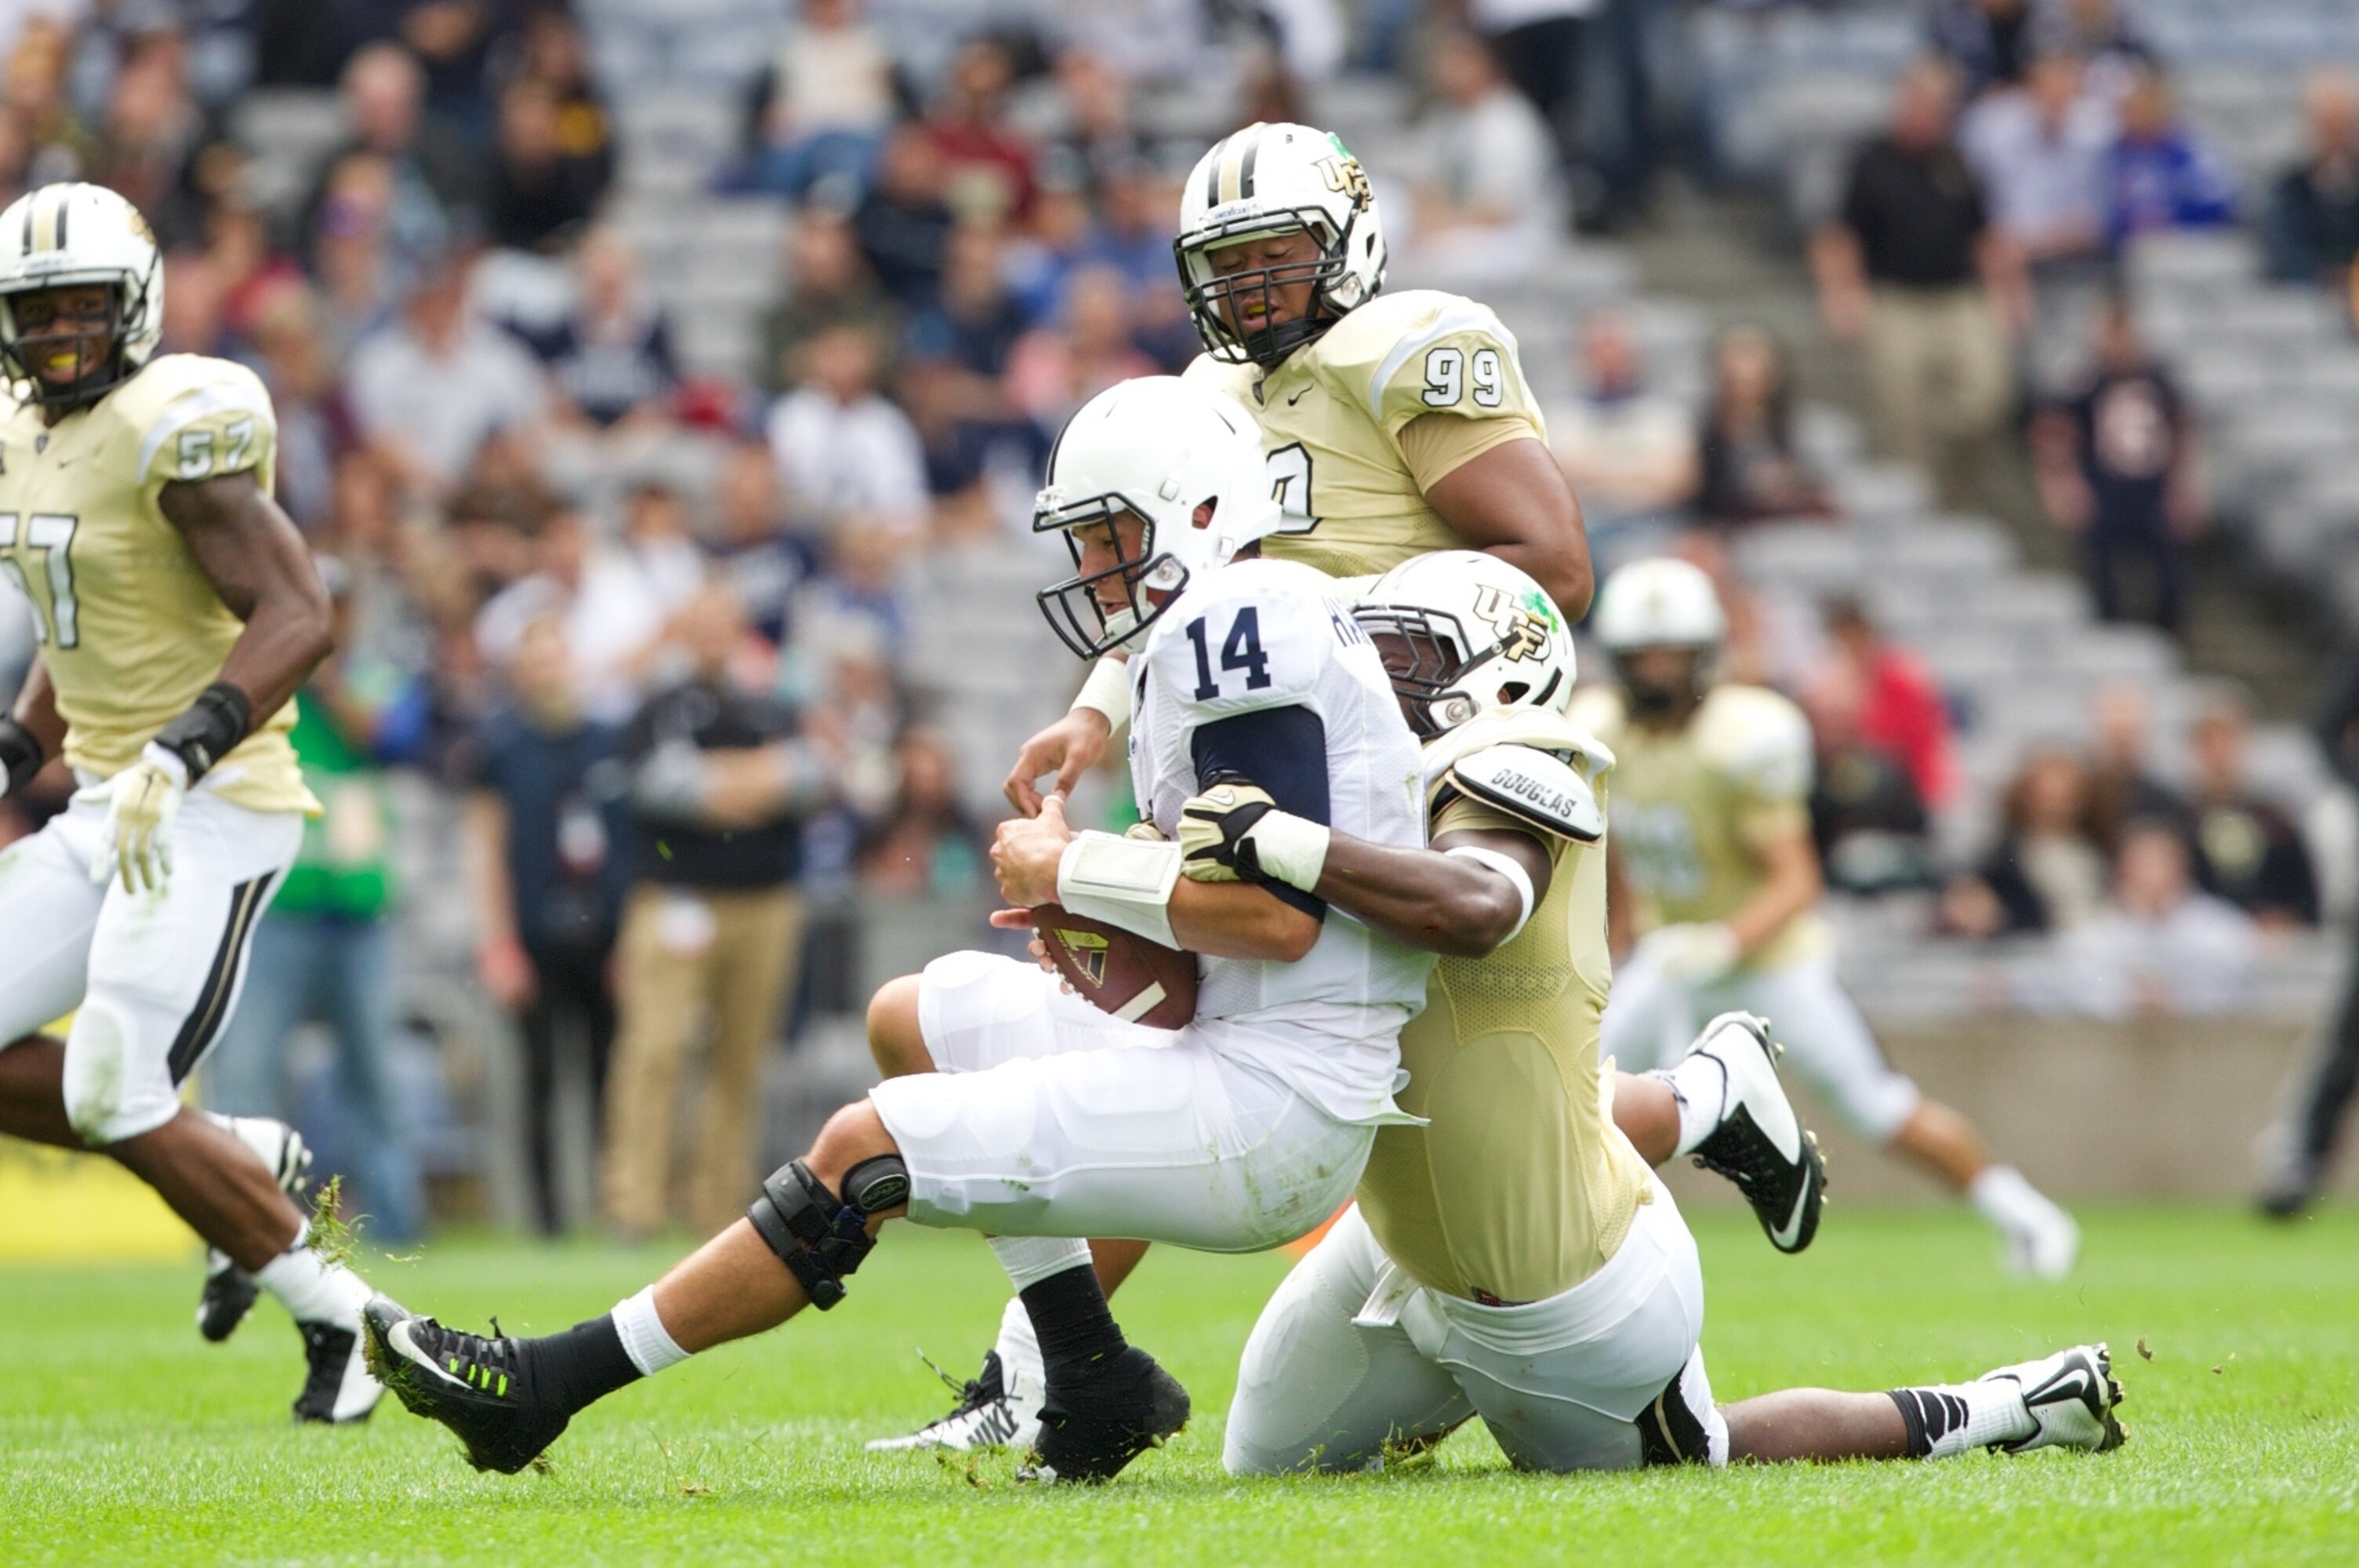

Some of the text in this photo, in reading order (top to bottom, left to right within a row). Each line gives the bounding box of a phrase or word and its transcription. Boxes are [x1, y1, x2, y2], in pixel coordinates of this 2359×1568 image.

[1422, 347, 1504, 408] 99
[177, 416, 254, 481] 57
[1185, 606, 1272, 702] 14
[1472, 583, 1546, 663] UCF
[1491, 768, 1578, 818] DOUGLAS
[967, 1403, 1020, 1445] NIKE
